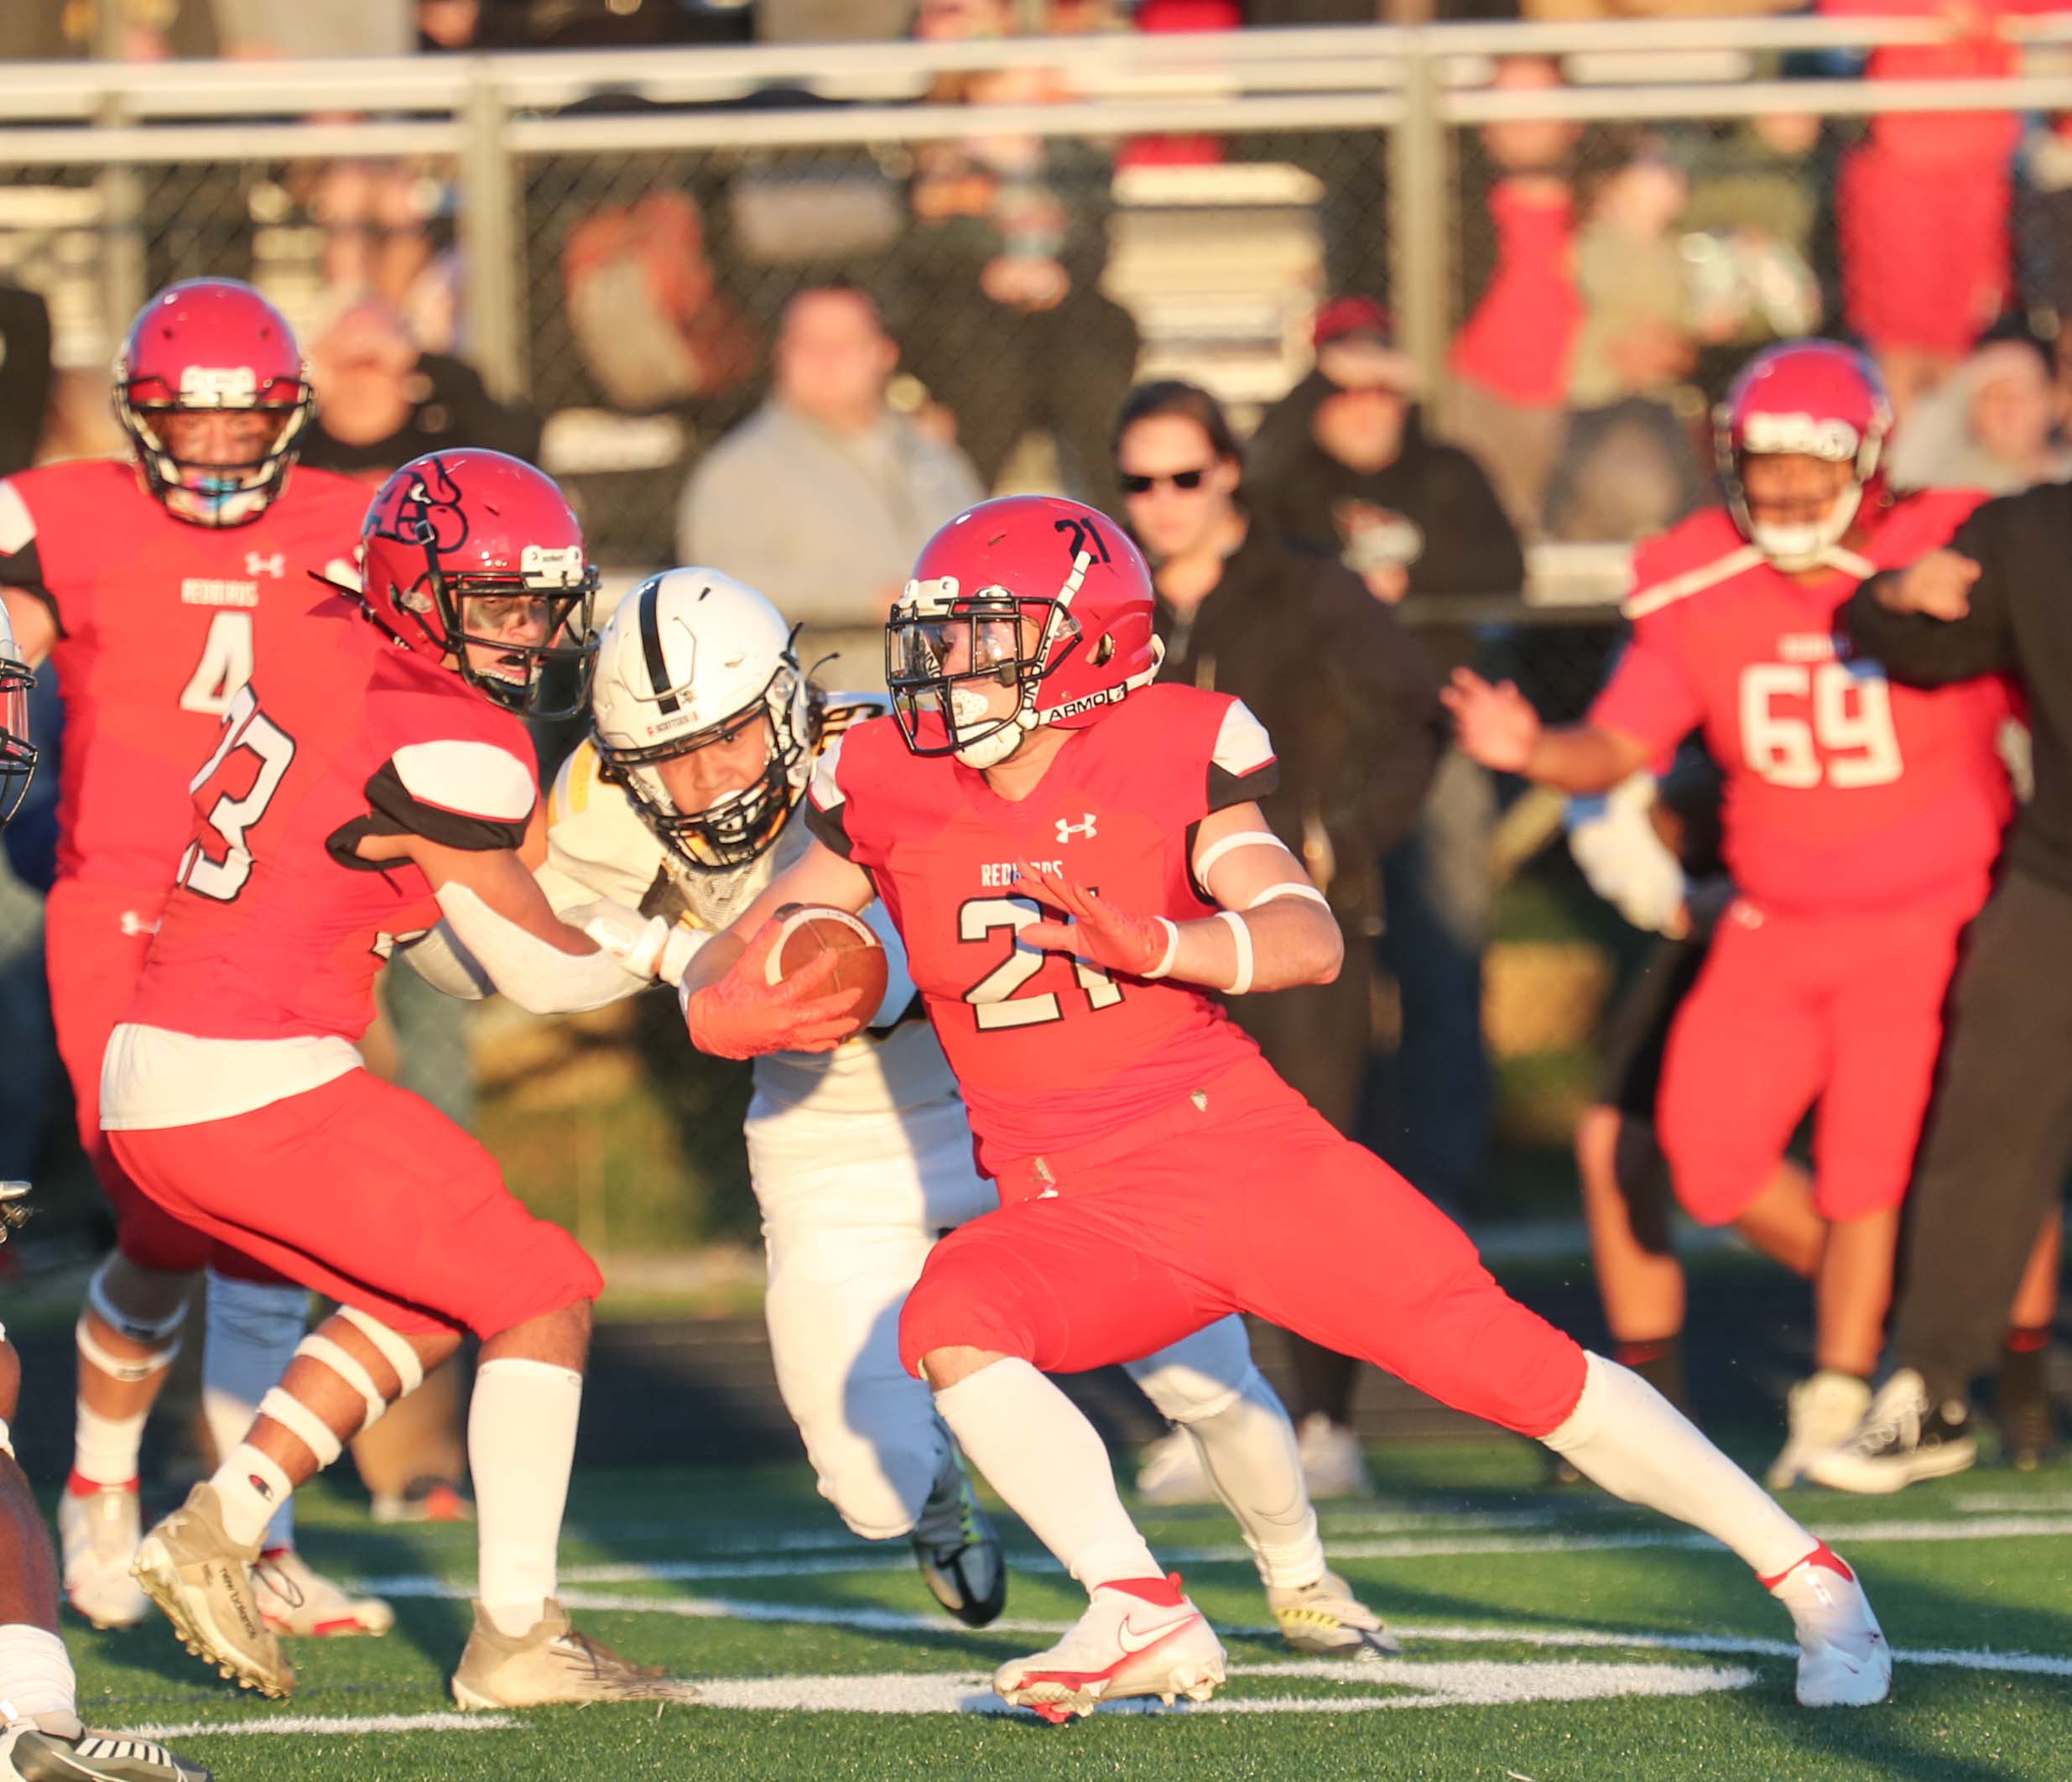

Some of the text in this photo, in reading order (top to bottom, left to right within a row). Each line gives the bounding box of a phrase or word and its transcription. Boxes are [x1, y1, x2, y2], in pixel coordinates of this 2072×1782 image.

[1054, 517, 1111, 565] 21
[179, 611, 254, 716] 4
[1740, 662, 1903, 789] 69
